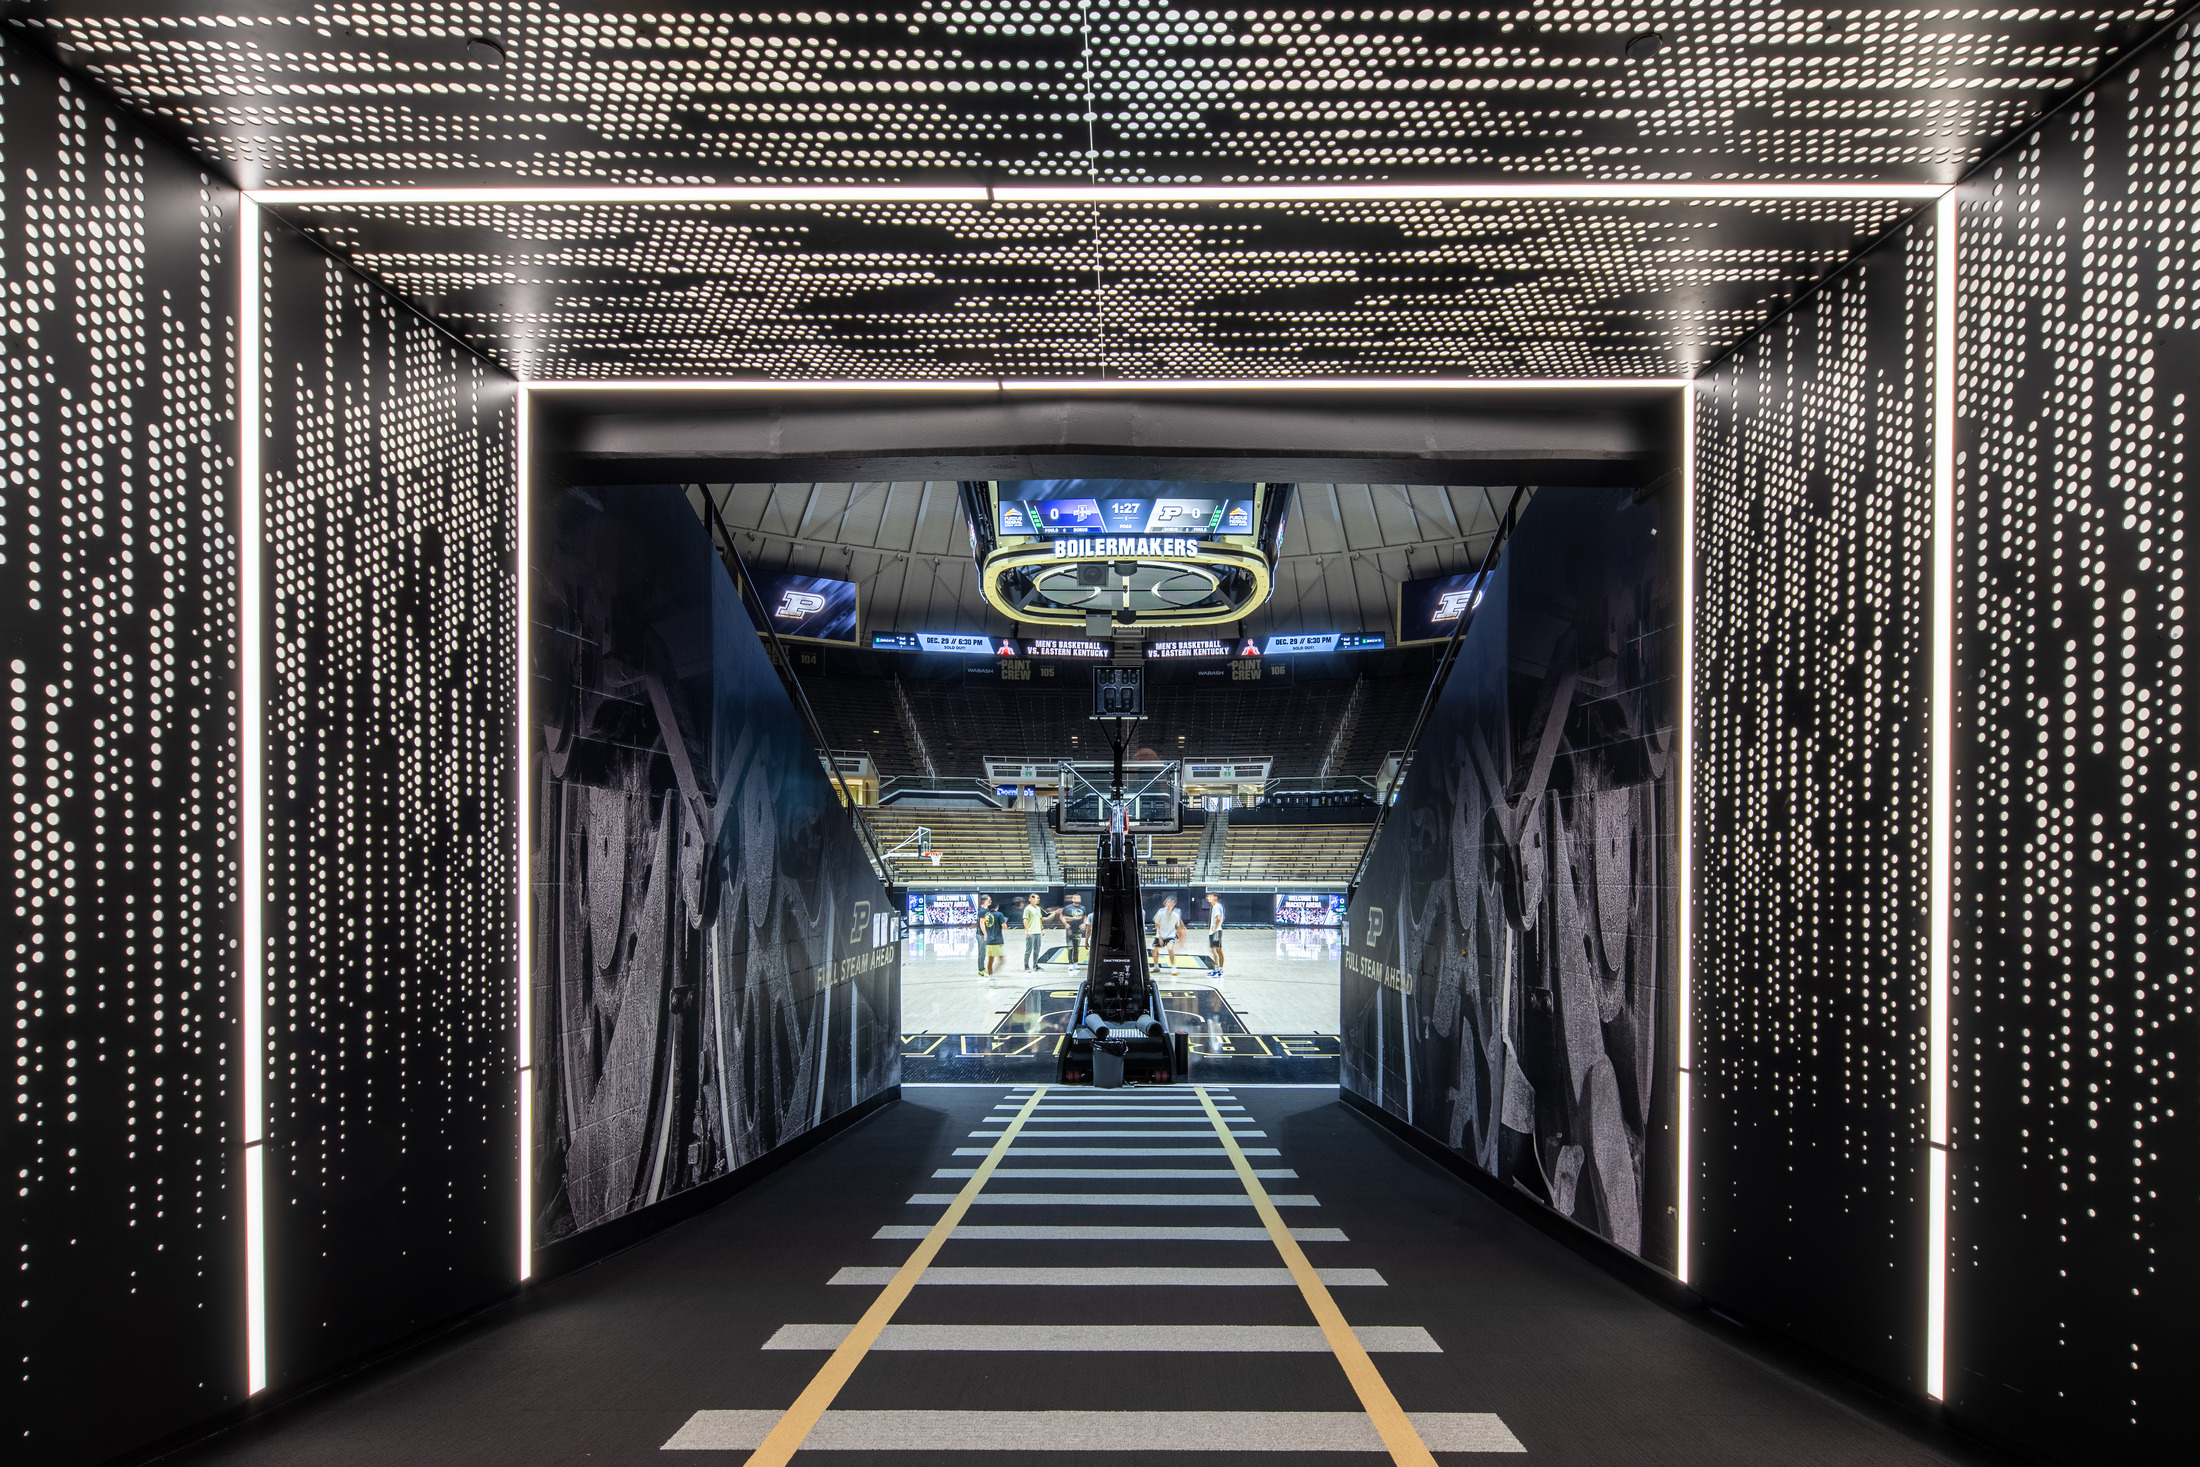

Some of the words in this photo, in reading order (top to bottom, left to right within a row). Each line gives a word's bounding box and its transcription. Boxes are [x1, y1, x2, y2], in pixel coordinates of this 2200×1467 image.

[1112, 503, 1140, 514] 1:27
[1192, 508, 1200, 518] 0
[1050, 508, 1059, 520] 0
[1055, 538, 1198, 558] BOILERMAKERS
[775, 590, 825, 620] P
[1035, 640, 1056, 648] MEN'S
[1059, 641, 1100, 650] BASKETBALL
[1156, 642, 1177, 650] MEN'S
[1179, 640, 1220, 649] BASKETBALL
[1041, 648, 1071, 656] EASTERN
[1073, 648, 1109, 657] KENTUCKY
[1162, 648, 1191, 657] EASTERN
[1193, 647, 1229, 656] KENTUCKY
[801, 655, 816, 664] 104
[1001, 660, 1031, 670] PAINT
[1232, 660, 1261, 670] PAINT
[1001, 670, 1031, 680] CREW
[1040, 668, 1055, 677] 105
[1232, 670, 1261, 680] CREW
[1271, 666, 1285, 675] 106
[996, 788, 1034, 796] Domio's
[850, 901, 870, 944] P
[1366, 907, 1384, 947] P
[817, 963, 838, 990] FULL
[841, 953, 868, 981] STEAM
[870, 946, 894, 970] AHEAD
[1346, 951, 1358, 972] FULL
[1360, 956, 1382, 982] STEAM
[1384, 966, 1412, 995] AHEAD
